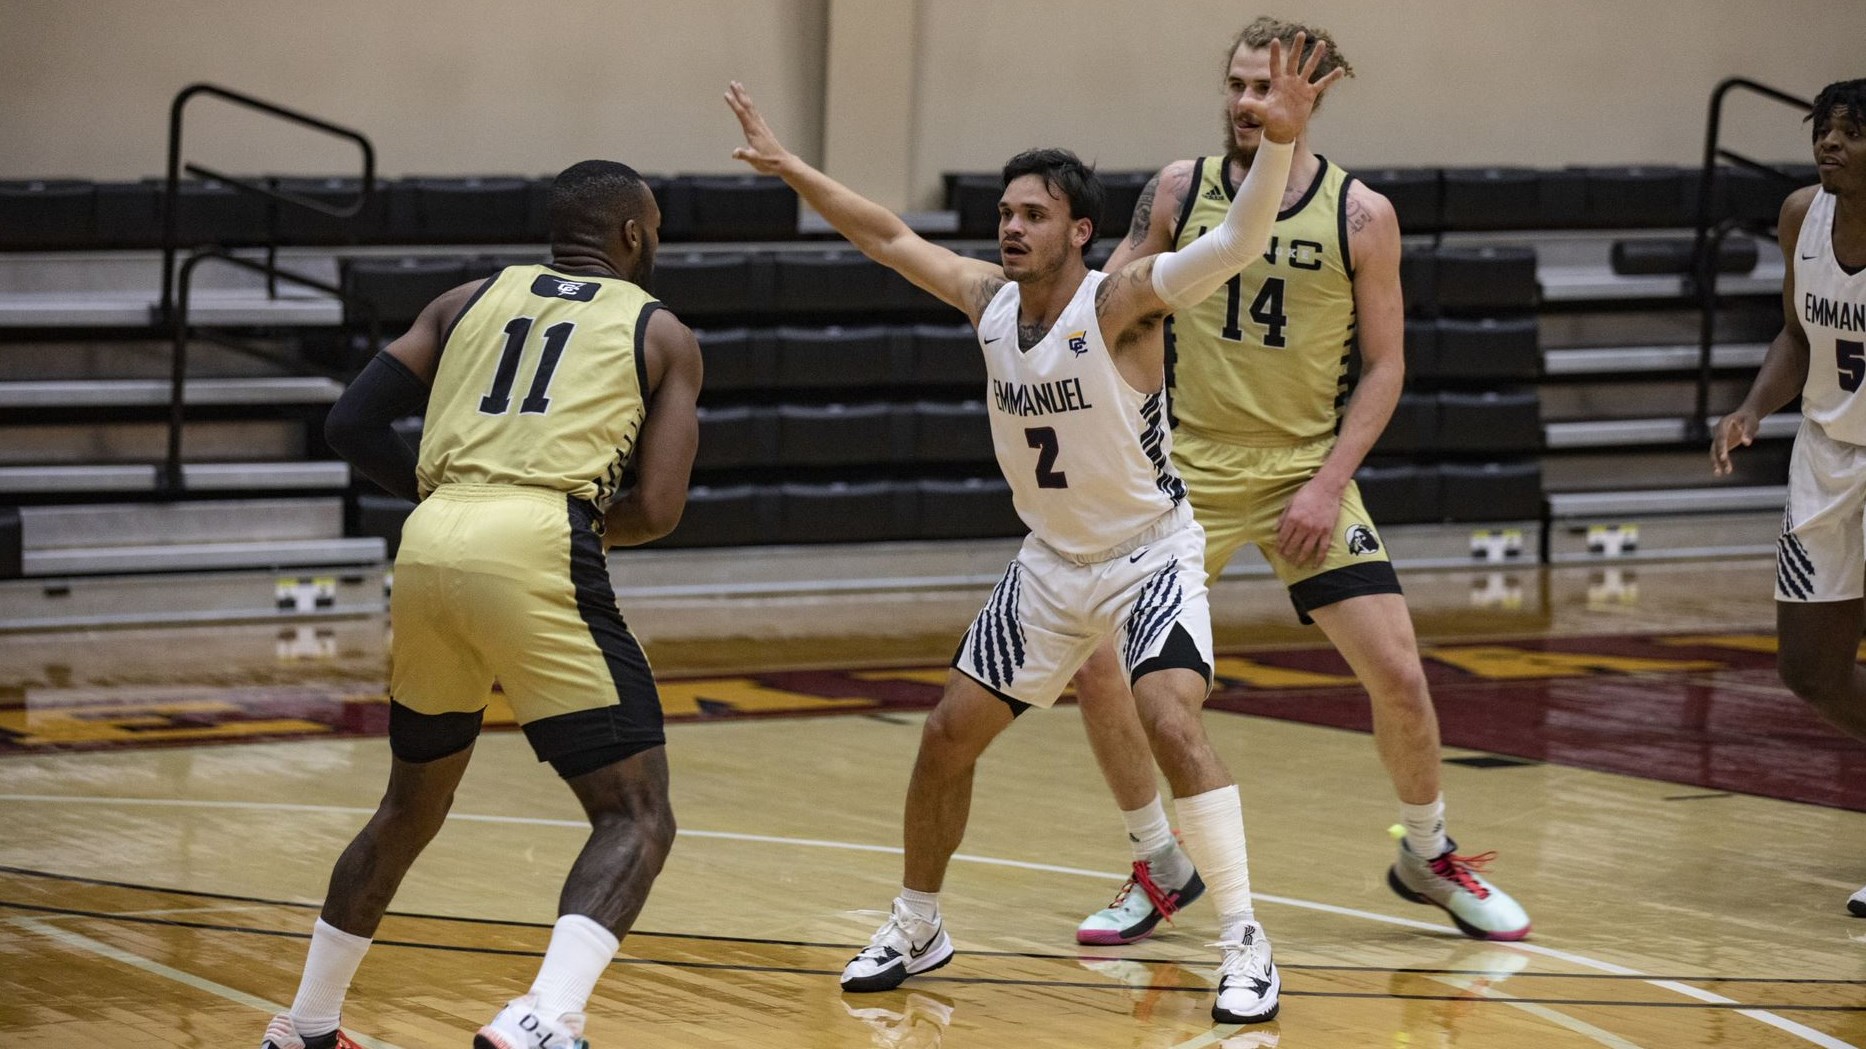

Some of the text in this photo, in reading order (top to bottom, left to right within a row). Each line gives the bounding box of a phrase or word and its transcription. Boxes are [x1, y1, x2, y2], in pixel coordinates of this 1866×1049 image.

[1222, 273, 1287, 348] 14
[479, 315, 576, 416] 11
[1836, 338, 1866, 394] 5
[993, 378, 1092, 417] EMMANUEL
[1024, 426, 1069, 489] 2
